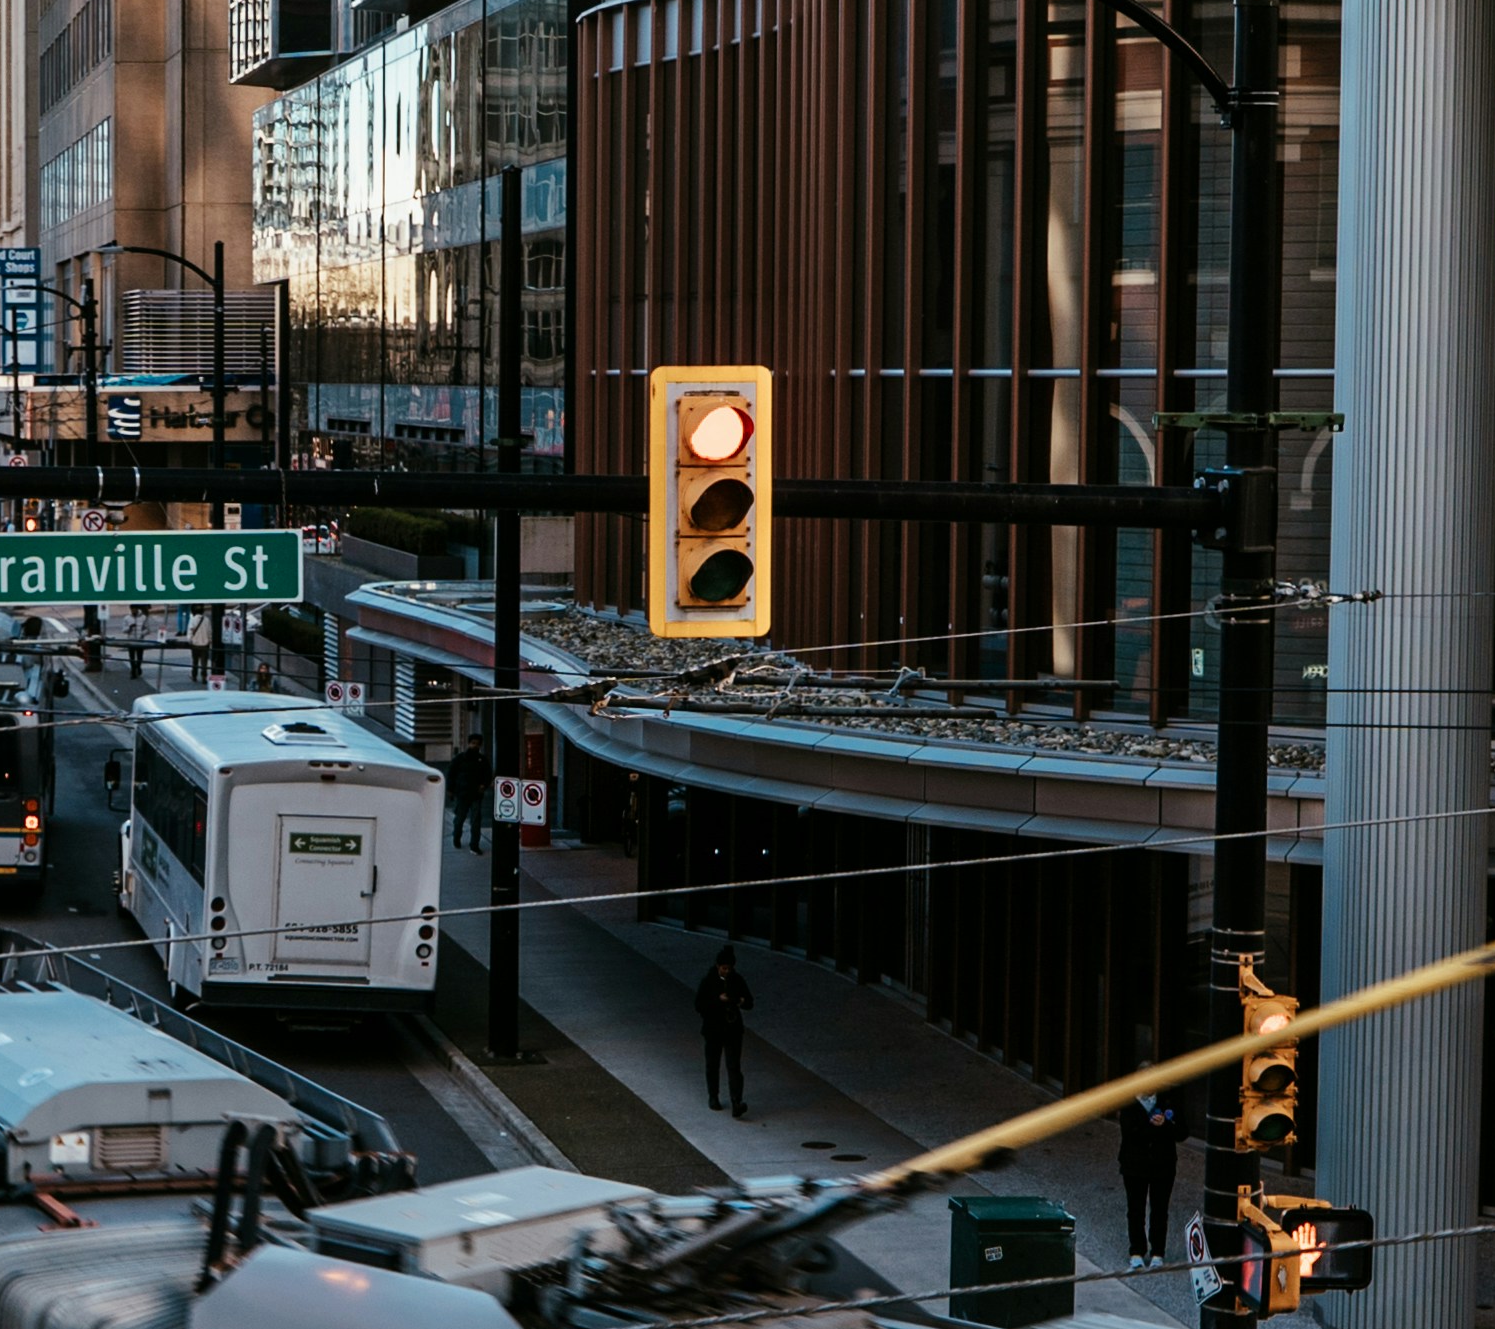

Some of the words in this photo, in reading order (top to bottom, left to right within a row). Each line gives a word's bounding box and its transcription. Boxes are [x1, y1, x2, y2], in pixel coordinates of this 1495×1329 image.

[8, 249, 36, 261] Court
[5, 262, 36, 274] Shops
[223, 545, 269, 591] St
